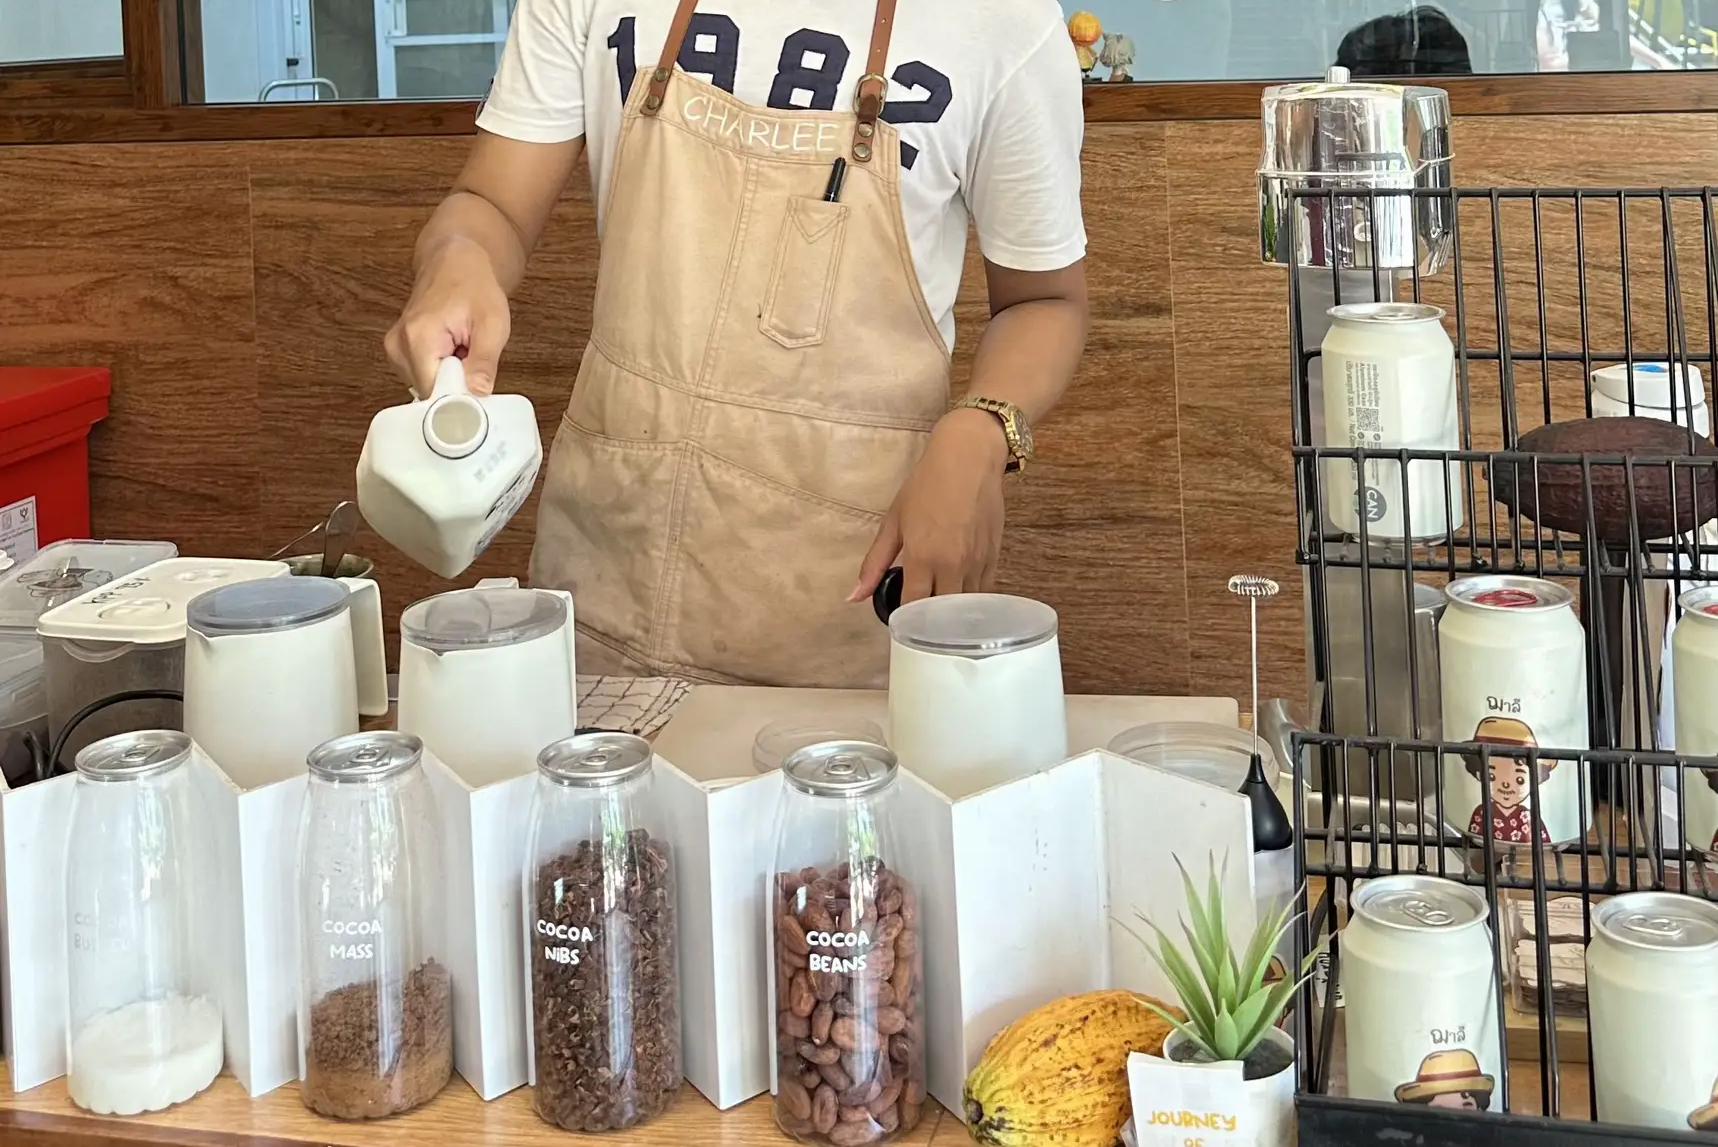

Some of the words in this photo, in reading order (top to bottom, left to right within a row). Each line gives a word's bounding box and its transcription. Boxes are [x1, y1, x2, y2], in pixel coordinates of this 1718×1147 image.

[683, 95, 841, 153] CHARLEE
[1366, 489, 1379, 519] CAN
[322, 919, 383, 936] COCOA
[537, 919, 594, 943] COCOA
[806, 930, 870, 948] COCOA
[330, 943, 374, 959] MASS
[809, 953, 868, 973] BEANS
[1147, 1110, 1237, 1132] JOURNEY
